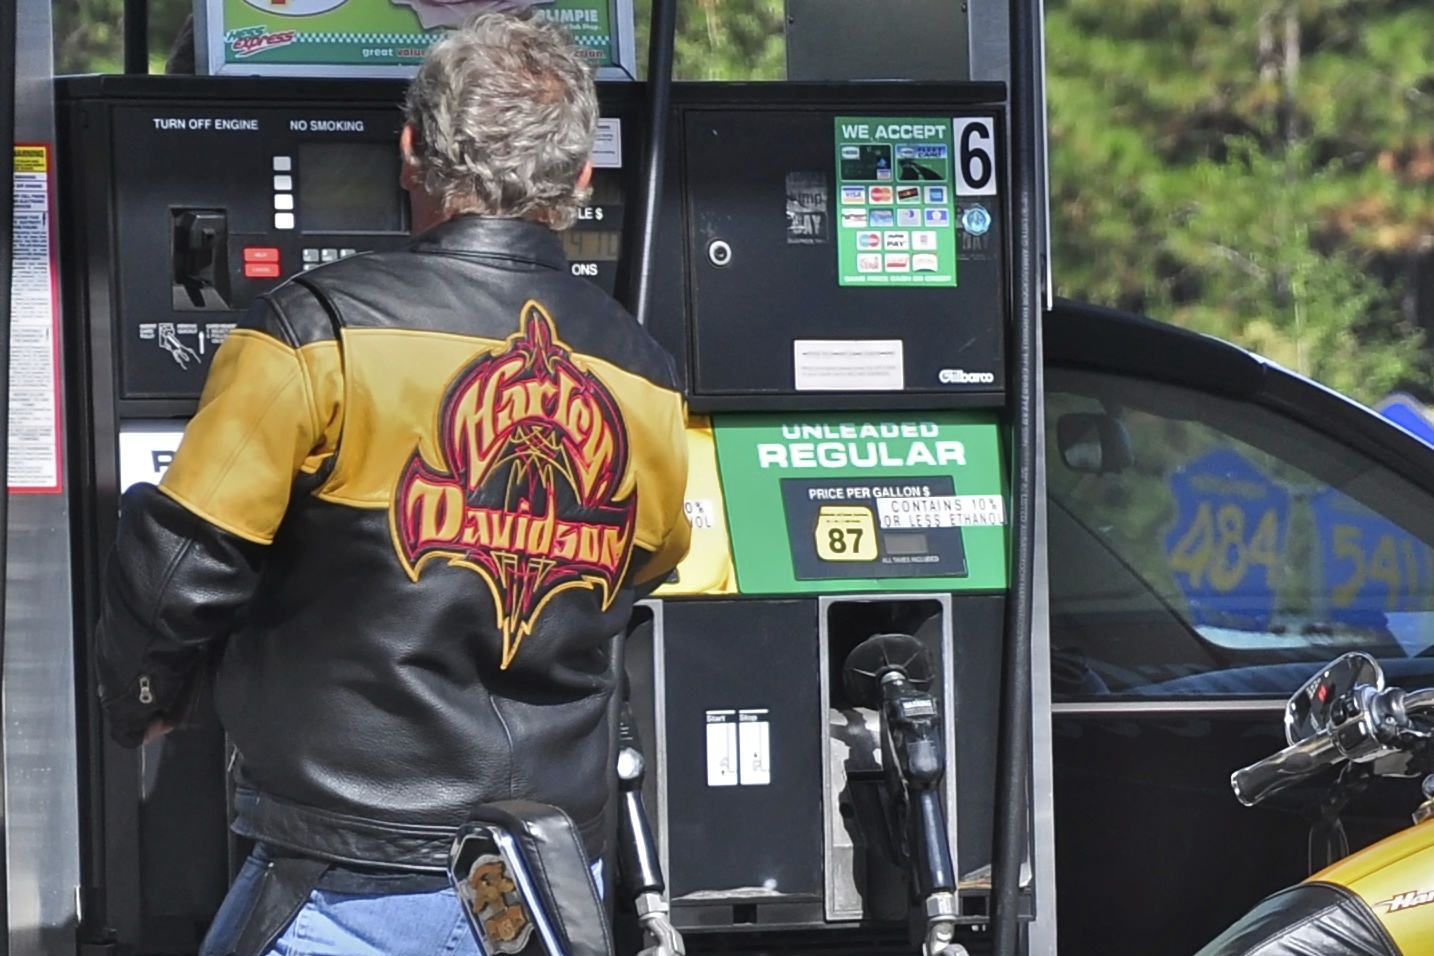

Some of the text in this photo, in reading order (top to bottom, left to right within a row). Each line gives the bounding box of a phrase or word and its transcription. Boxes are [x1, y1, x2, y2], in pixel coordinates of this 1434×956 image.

[362, 48, 393, 57] great
[153, 119, 258, 130] TURN OFF ENGINE
[290, 121, 364, 131] NO SMOKING
[842, 125, 946, 139] WE ACCEPT
[960, 121, 992, 190] 6
[939, 369, 994, 383] Gilbarco
[454, 357, 615, 496] Harley
[781, 422, 939, 440] UNLEADED
[757, 441, 967, 468] REGULAR
[809, 486, 931, 499] PRICE PER GALLON $
[891, 498, 998, 513] CONTAINS 10%
[404, 480, 630, 567] Davidson
[884, 513, 1007, 528] OR LESS ETHANOL
[827, 528, 864, 554] 87
[1169, 501, 1281, 592] 484
[706, 714, 758, 722] Start Stop
